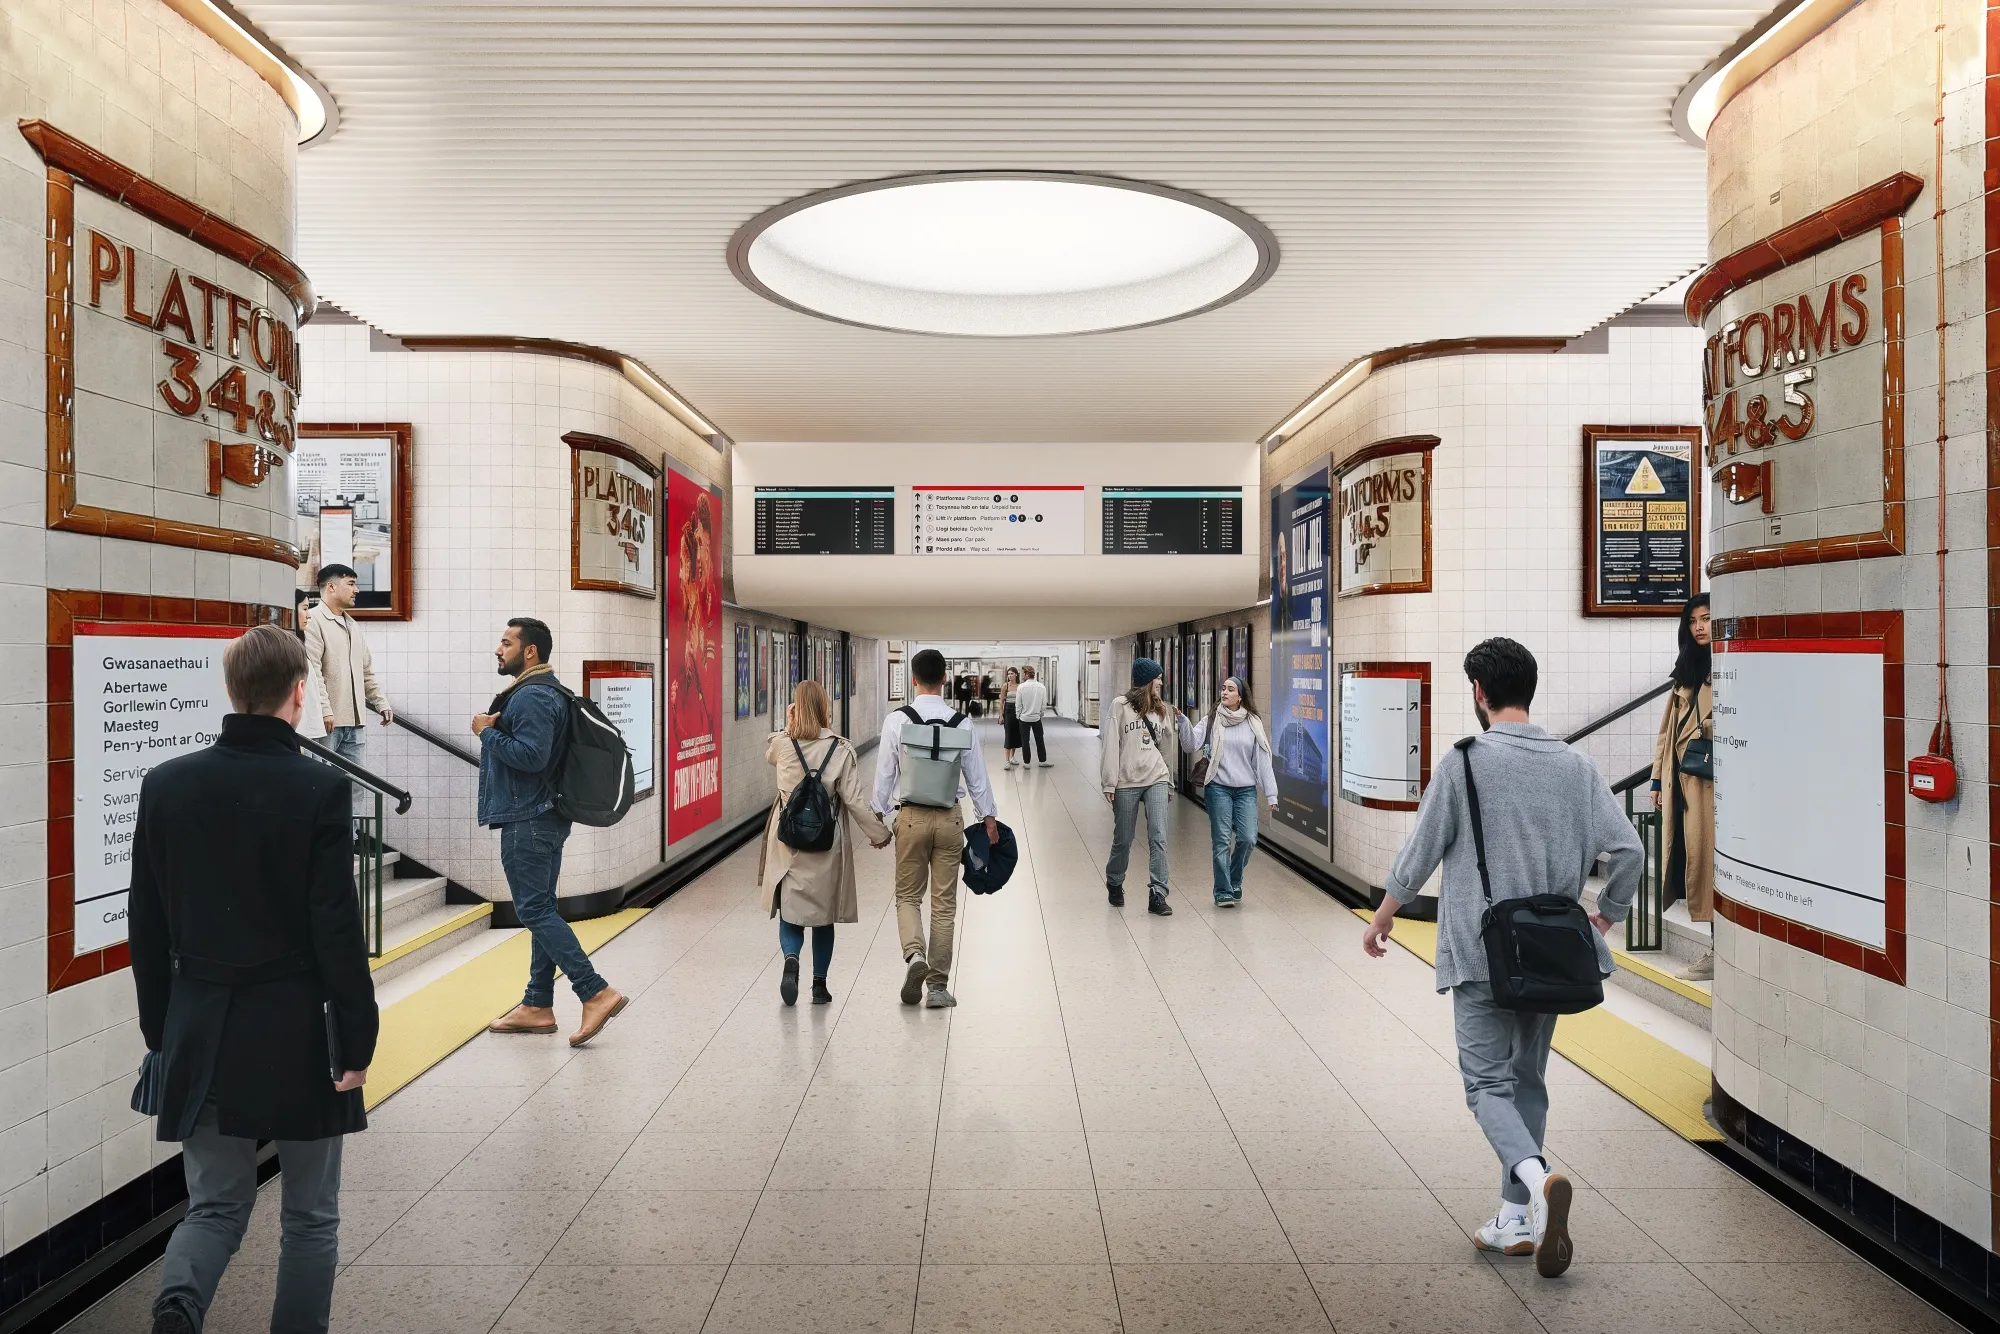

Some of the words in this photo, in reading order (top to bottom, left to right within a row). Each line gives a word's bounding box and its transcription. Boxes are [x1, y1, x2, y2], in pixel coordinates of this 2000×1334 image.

[88, 229, 300, 397] PLATFOR
[1307, 515, 1322, 571] JOEL
[103, 656, 202, 670] Gwasanaethau
[205, 656, 209, 668] i
[103, 681, 168, 694] Abertawe
[103, 699, 167, 713] Gorllewin
[170, 697, 208, 712] Cymru
[104, 720, 159, 733] Maesteg
[104, 734, 178, 752] Pen-y-bont
[180, 735, 192, 745] ar
[195, 731, 222, 745] Ogw
[1729, 735, 1748, 749] Ogwr
[103, 766, 154, 783] Servic
[103, 792, 141, 807] Swan
[103, 810, 137, 826] West
[104, 849, 132, 866] Brid
[1757, 882, 1775, 897] keep
[1776, 889, 1784, 899] to
[1785, 891, 1798, 902] the
[1800, 895, 1814, 907] left
